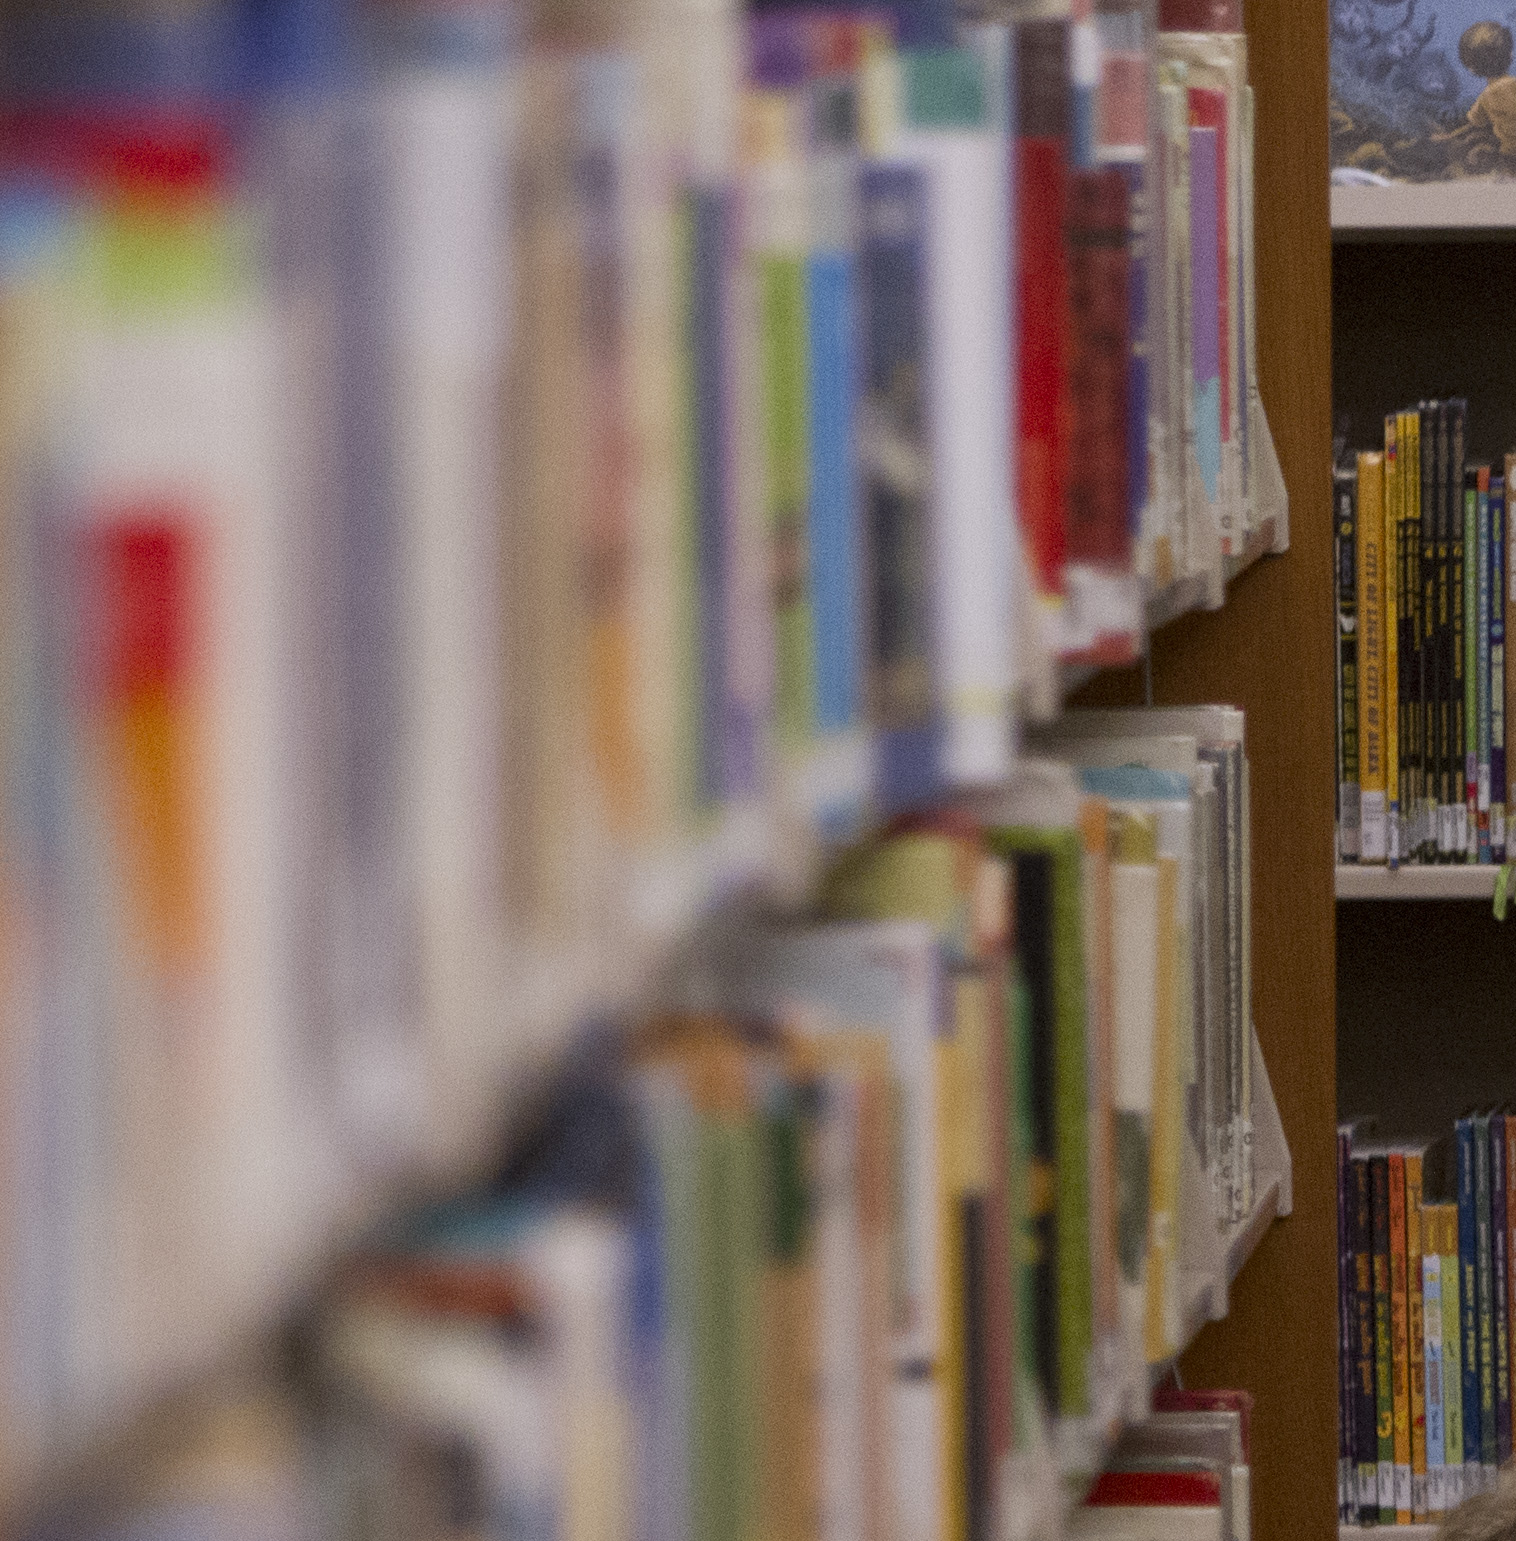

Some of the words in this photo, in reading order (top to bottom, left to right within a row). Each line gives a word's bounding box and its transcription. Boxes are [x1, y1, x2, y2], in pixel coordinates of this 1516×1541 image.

[1366, 542, 1379, 578] CITY
[1366, 583, 1379, 604] OF
[1366, 666, 1379, 702] CITY
[1366, 707, 1379, 727] OF
